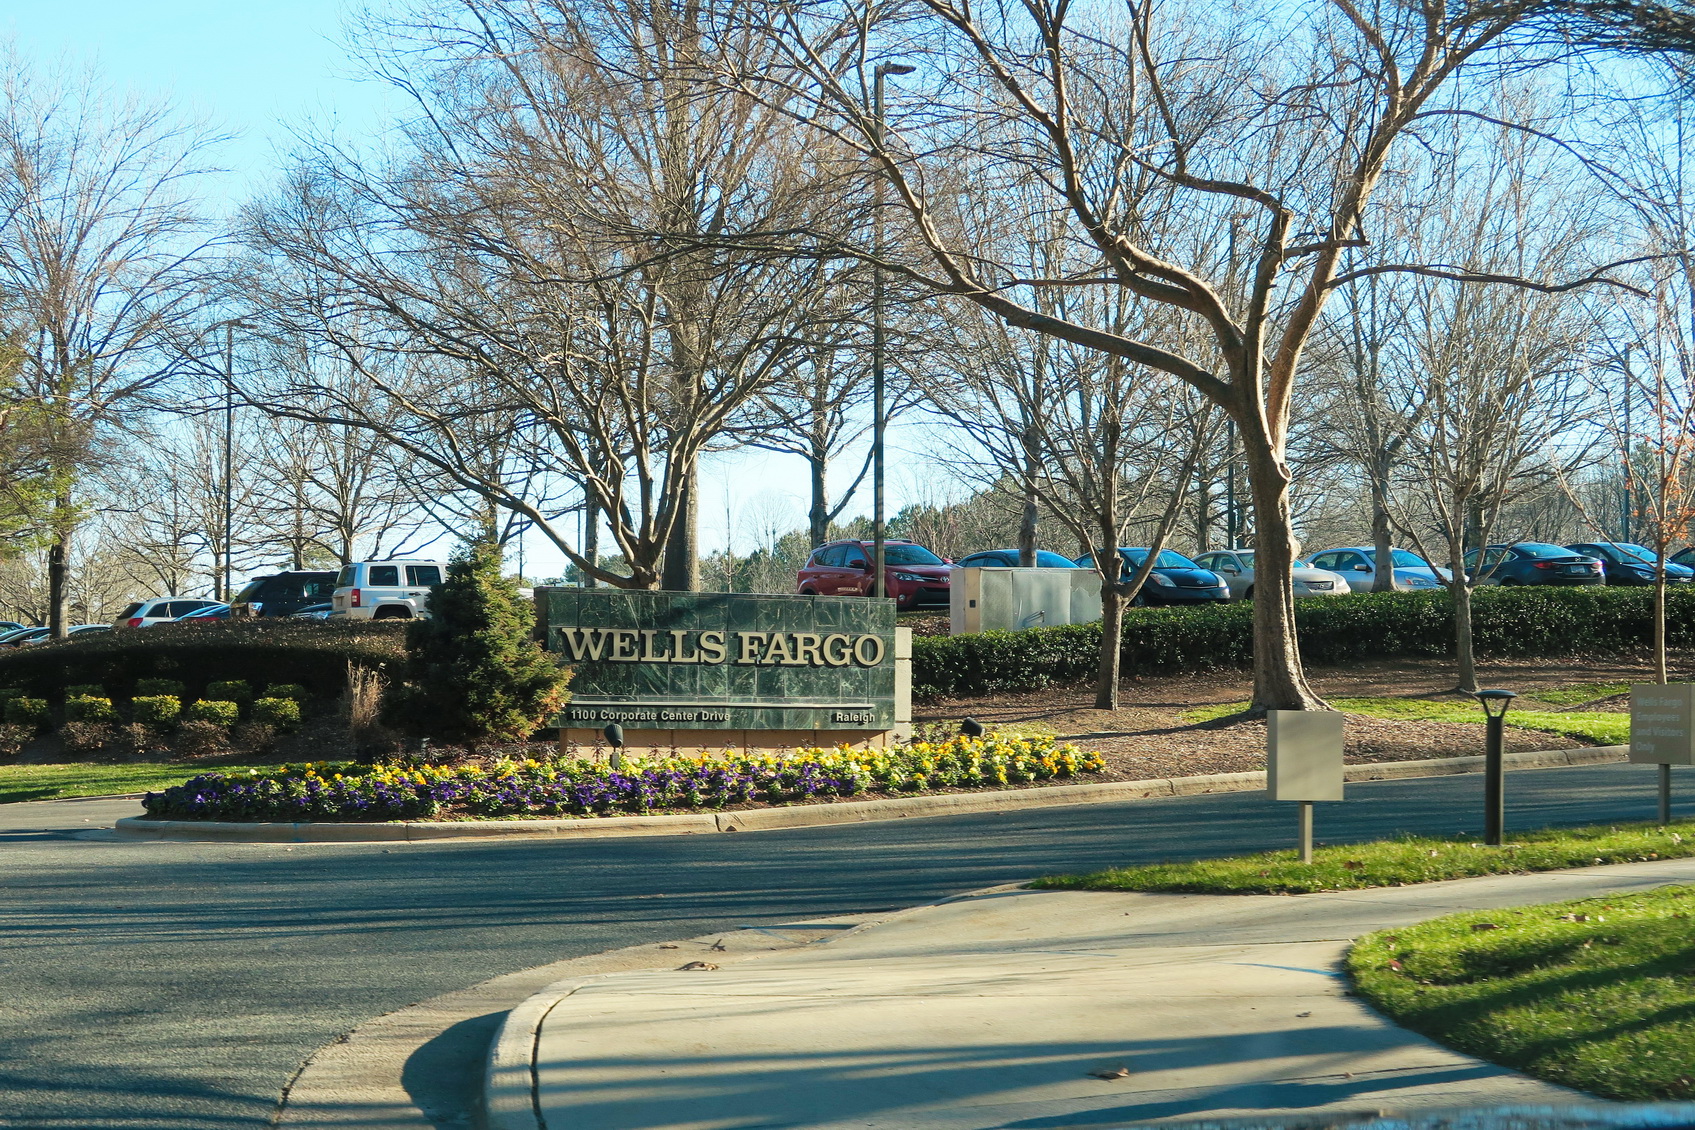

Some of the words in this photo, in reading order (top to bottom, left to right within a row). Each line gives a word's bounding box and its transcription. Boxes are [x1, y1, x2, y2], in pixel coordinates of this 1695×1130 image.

[561, 627, 727, 664] WELLS
[737, 631, 885, 667] FARGO
[1636, 697, 1657, 706] Wells
[1659, 697, 1682, 708] Fargo
[570, 709, 596, 720] 1100
[600, 710, 657, 722] Corporate
[660, 711, 698, 721] Center
[702, 711, 730, 721] Drive
[836, 712, 875, 723] Raleigh
[1636, 712, 1680, 723] Employees
[1636, 727, 1651, 736] and
[1653, 727, 1684, 737] Visitors
[1636, 742, 1655, 753] Only
